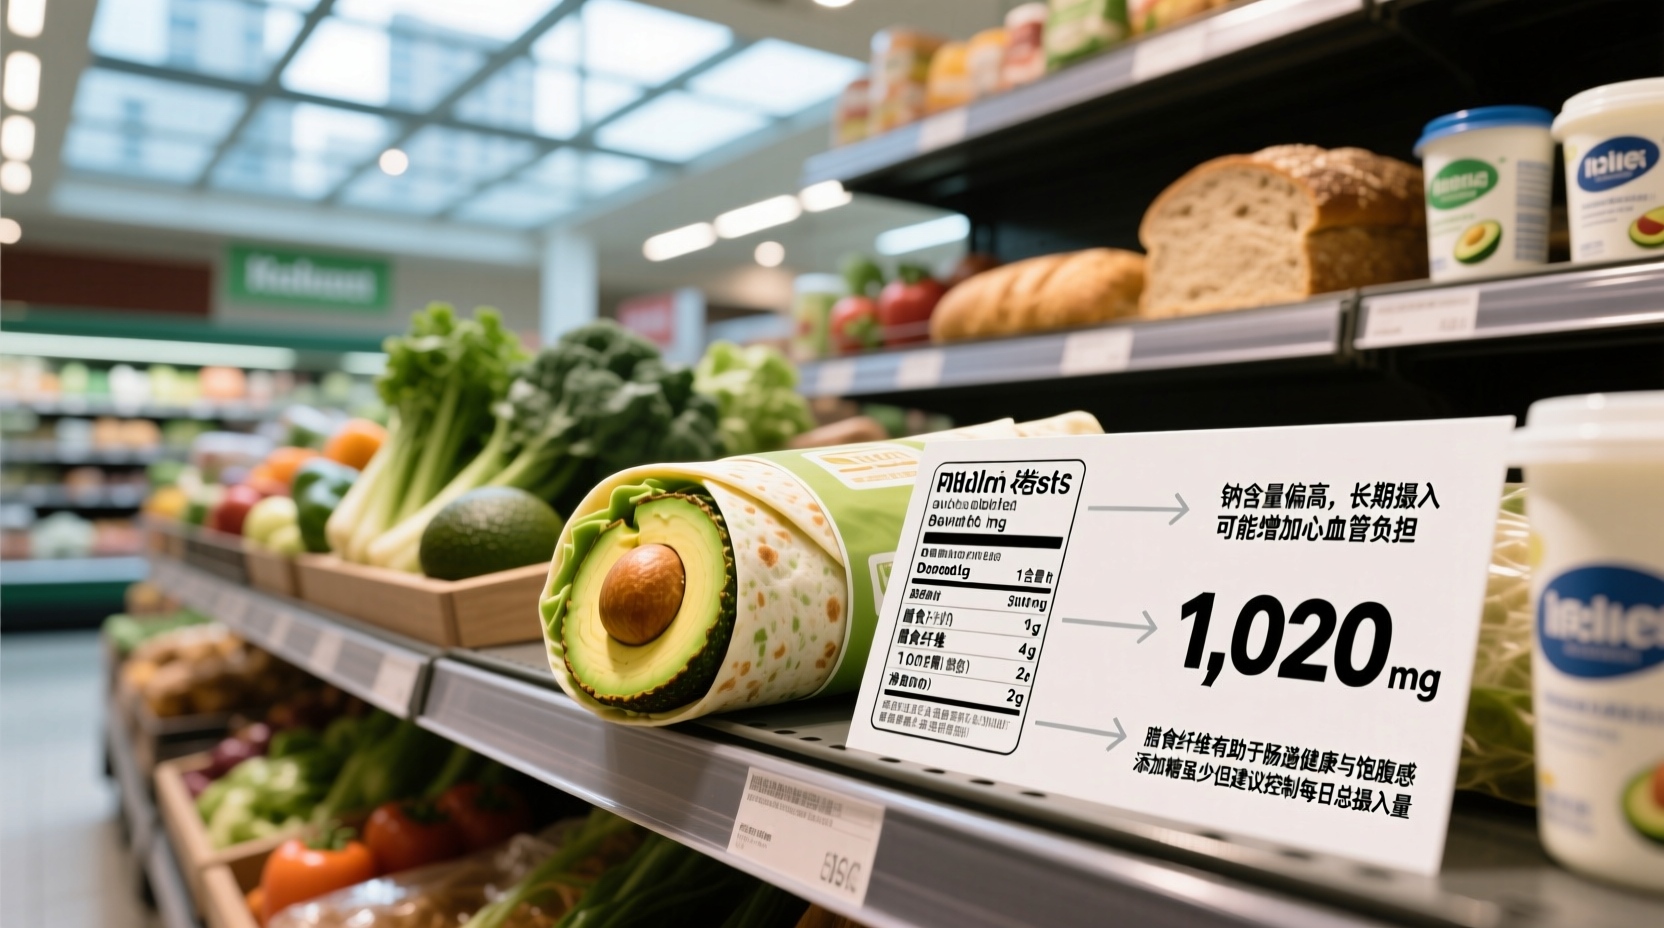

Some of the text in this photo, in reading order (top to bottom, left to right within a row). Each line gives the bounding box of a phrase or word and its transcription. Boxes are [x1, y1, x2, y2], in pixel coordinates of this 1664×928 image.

[1217, 514, 1418, 543] 可能增加心血管负担
[1018, 643, 1036, 660] 4g
[1181, 592, 1441, 702] 1,020 mg
[1006, 689, 1024, 707] 2g
